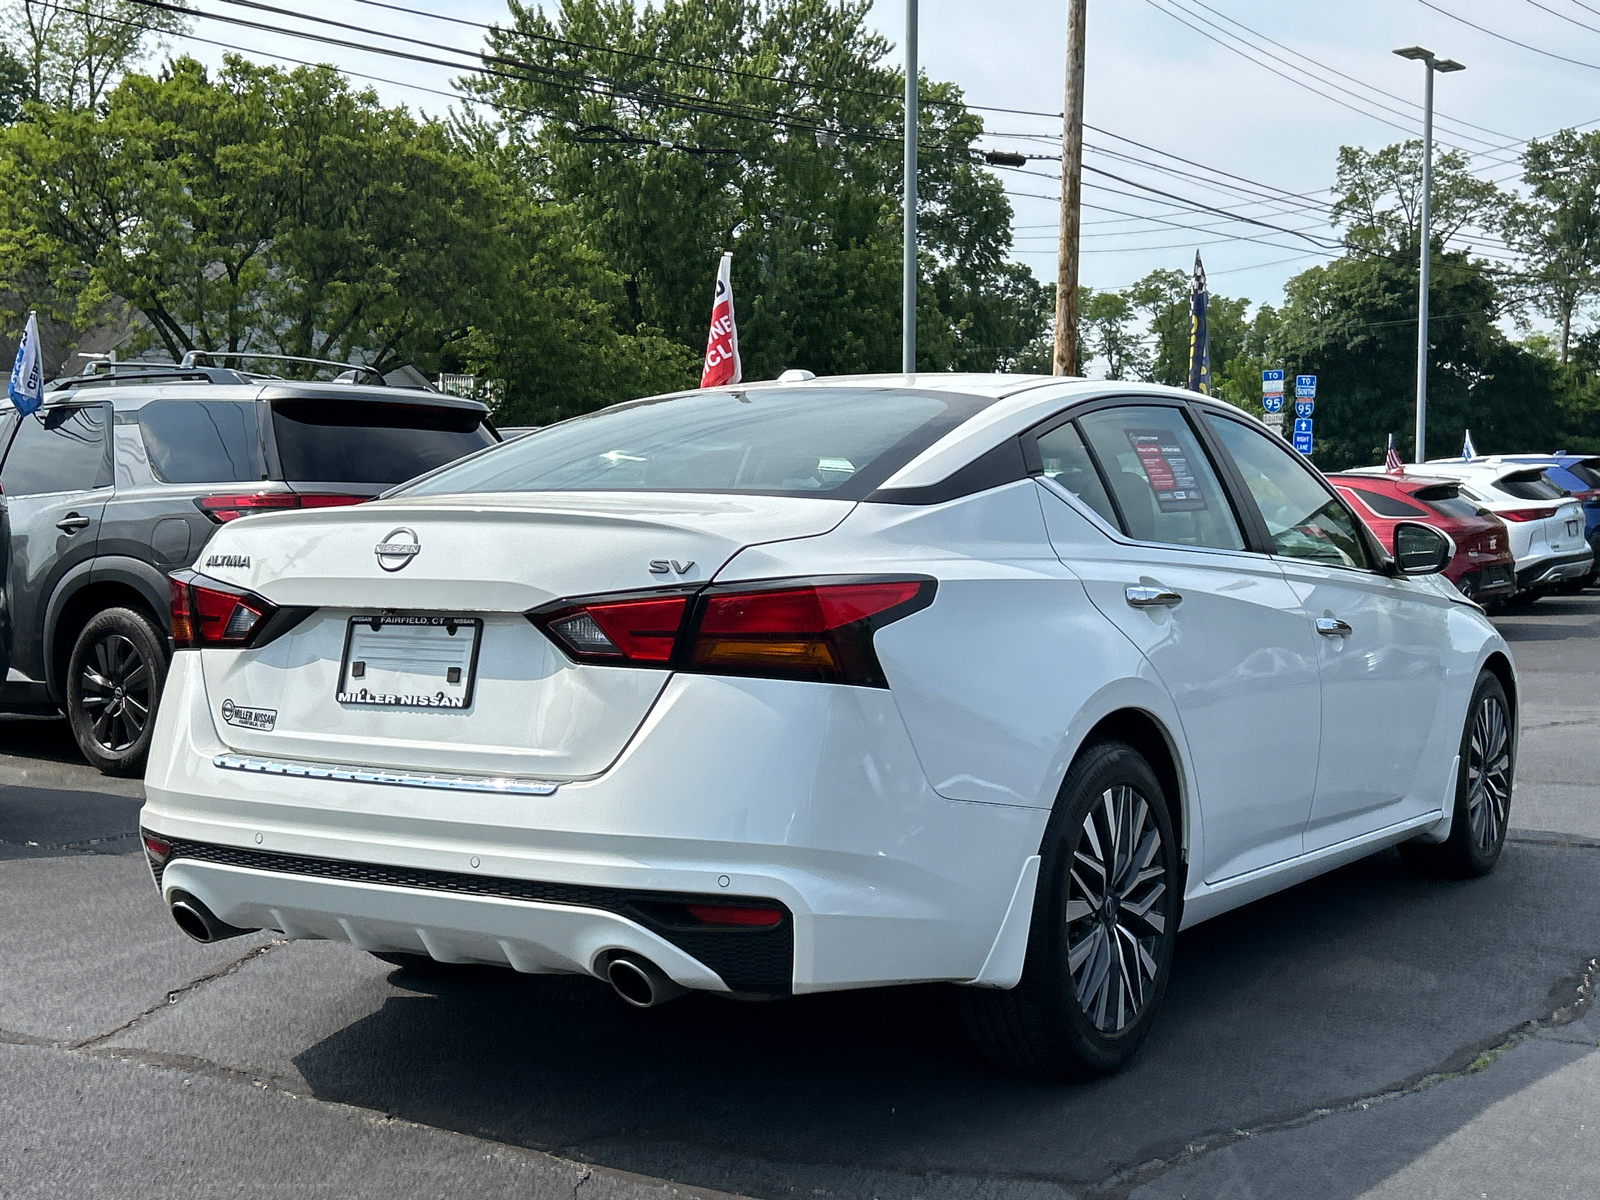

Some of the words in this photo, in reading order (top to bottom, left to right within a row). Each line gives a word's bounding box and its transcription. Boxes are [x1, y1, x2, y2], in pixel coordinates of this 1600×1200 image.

[709, 315, 732, 344] NE
[1268, 372, 1278, 380] TO
[1297, 388, 1315, 396] SOUTH
[1266, 398, 1280, 409] 95
[1298, 404, 1311, 414] 95
[376, 544, 420, 554] NISSAN
[205, 555, 251, 568] ALTIMA
[648, 559, 696, 575] SV
[380, 616, 430, 625] FAIRFIELD,
[431, 617, 445, 625] CT
[337, 692, 396, 704] MILLER
[400, 695, 464, 707] NISSAN
[234, 709, 253, 720] MILLER
[253, 712, 275, 724] NISSAN
